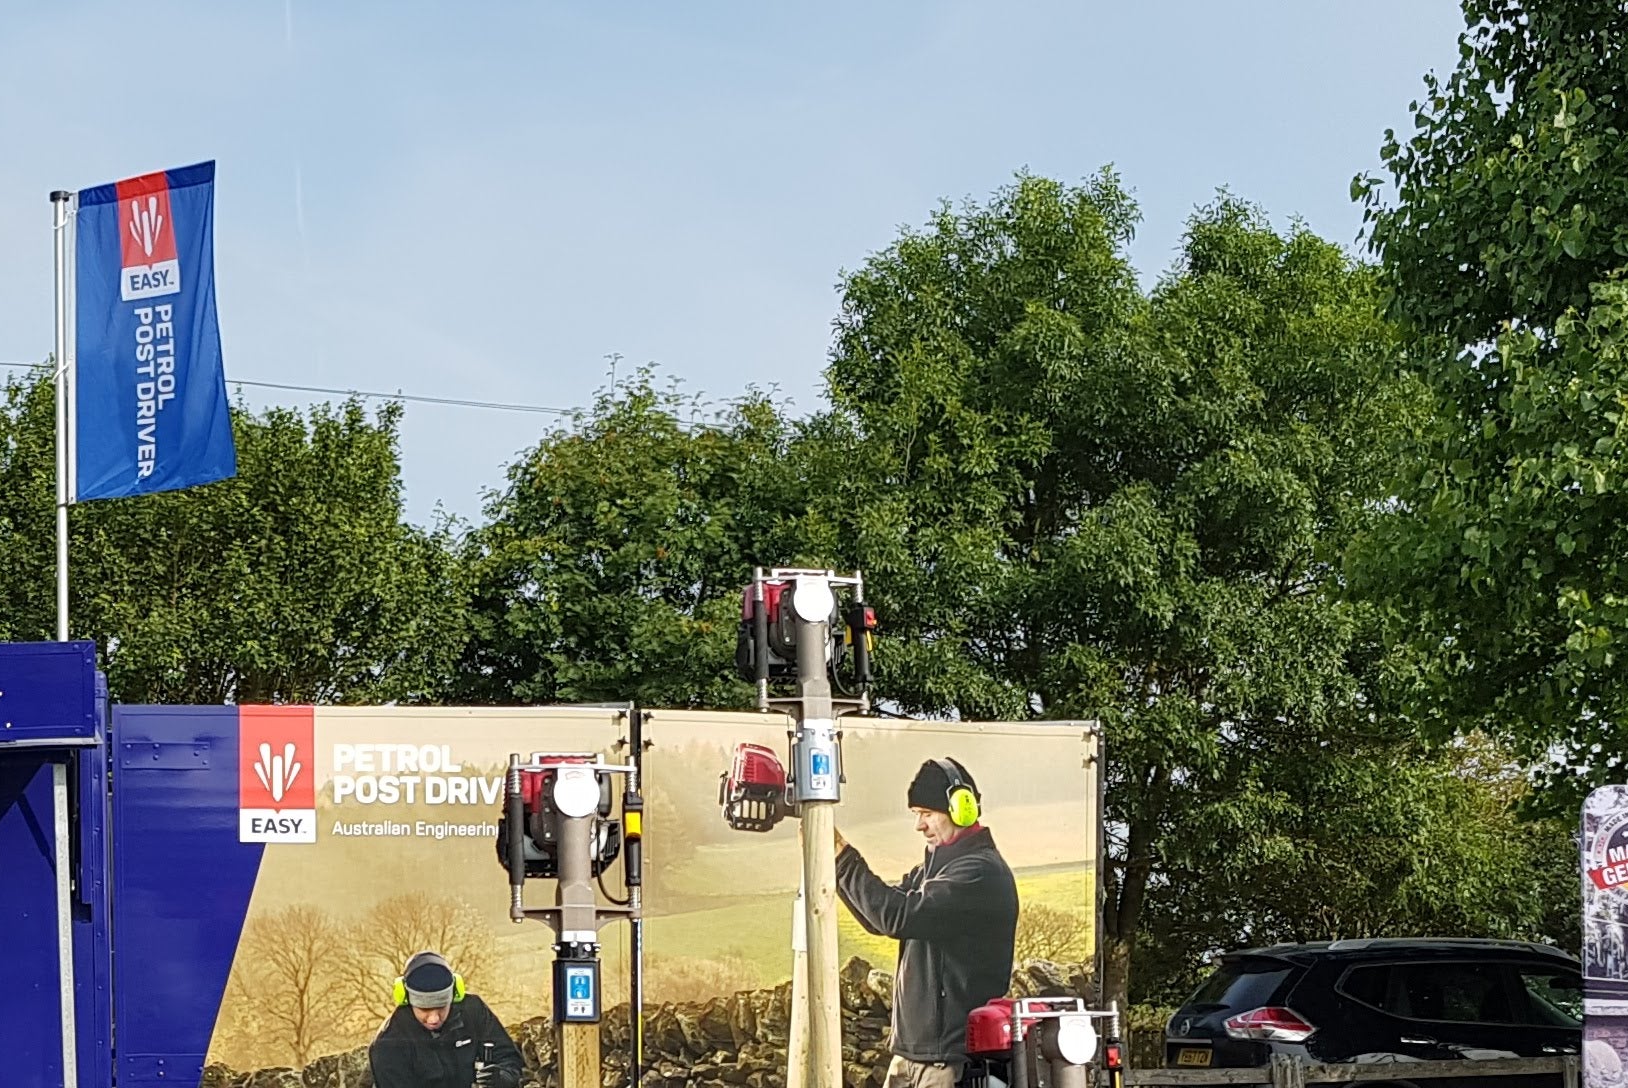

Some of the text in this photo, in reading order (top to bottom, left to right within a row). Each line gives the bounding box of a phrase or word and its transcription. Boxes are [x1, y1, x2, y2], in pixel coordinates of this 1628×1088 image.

[130, 270, 168, 291] EASY
[155, 304, 175, 410] PETROL
[133, 307, 157, 478] POST DRIVER
[334, 744, 461, 772] PETROL
[334, 775, 506, 804] POST DRIV
[252, 818, 303, 833] EASY
[332, 821, 498, 839] Australian Engineerin
